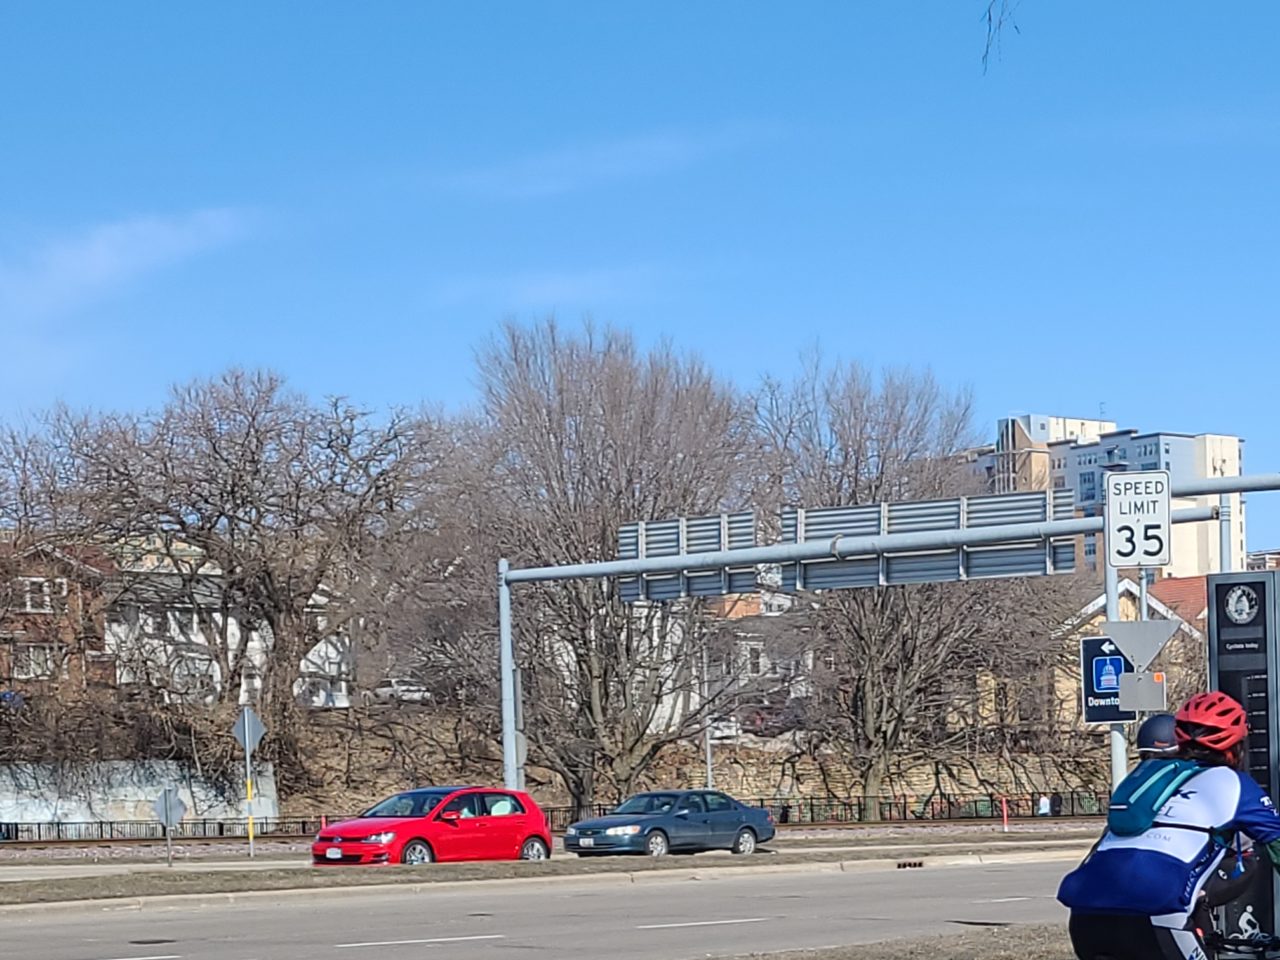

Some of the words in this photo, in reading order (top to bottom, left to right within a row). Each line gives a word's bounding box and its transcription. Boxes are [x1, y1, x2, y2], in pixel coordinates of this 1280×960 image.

[1113, 481, 1164, 496] SPEED
[1119, 500, 1159, 515] LIMIT
[1116, 524, 1164, 558] 35
[1088, 696, 1120, 707] Downto
